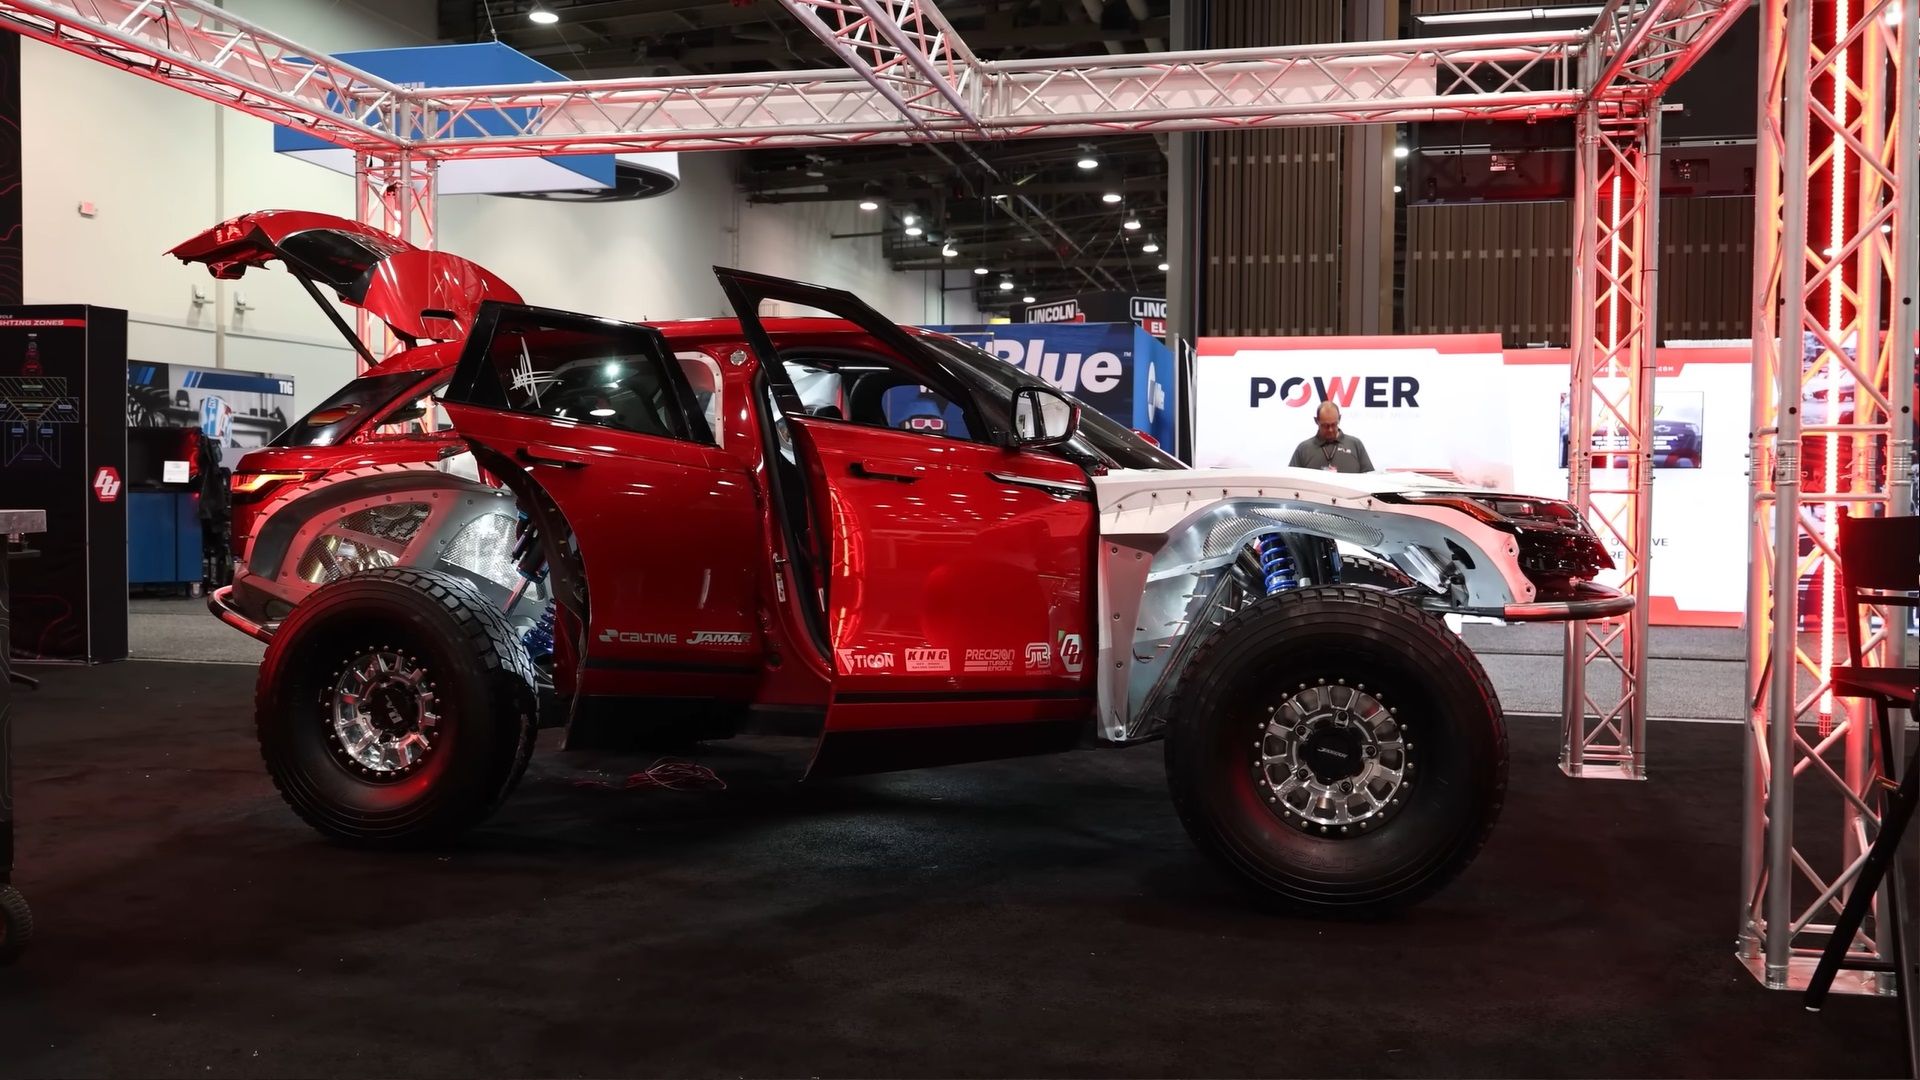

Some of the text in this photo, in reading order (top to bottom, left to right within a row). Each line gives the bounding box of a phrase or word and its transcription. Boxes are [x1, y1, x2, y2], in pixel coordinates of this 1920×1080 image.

[1028, 303, 1074, 323] LINCOLN
[1150, 321, 1166, 333] EL
[278, 380, 294, 395] TIG
[1249, 376, 1420, 408] POWER
[686, 631, 753, 645] JAMAR
[907, 650, 948, 661] KING
[965, 648, 1016, 660] PRECISION
